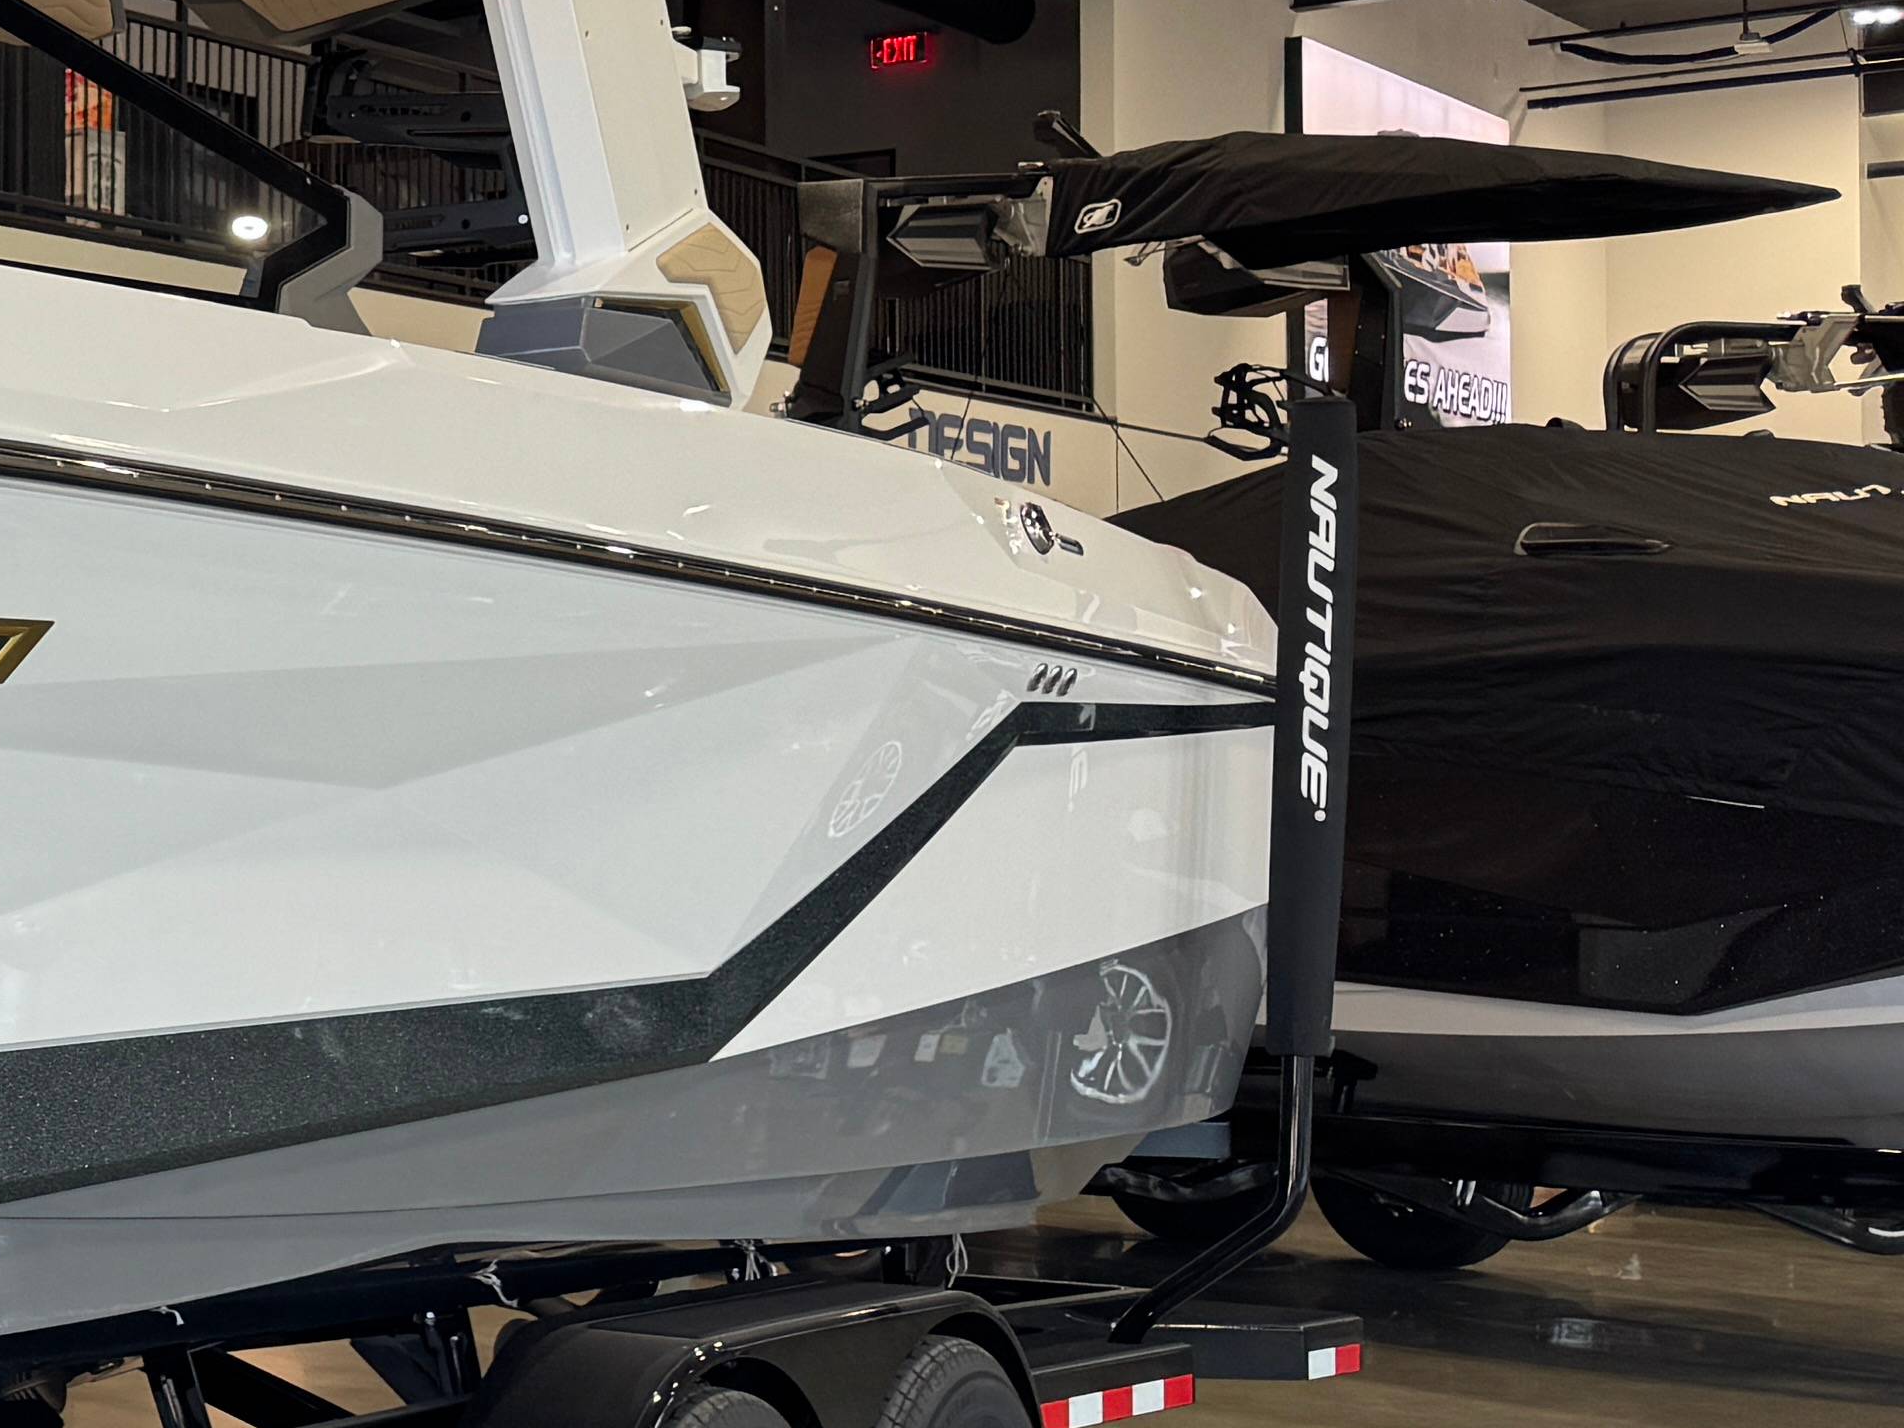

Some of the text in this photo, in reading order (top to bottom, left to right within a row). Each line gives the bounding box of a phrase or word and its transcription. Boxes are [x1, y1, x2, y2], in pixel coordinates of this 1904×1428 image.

[883, 35, 918, 64] EXIT
[1432, 369, 1509, 423] AHEAD!!!
[908, 407, 1052, 486] DESIGN
[1298, 453, 1340, 810] NAUTIQUE
